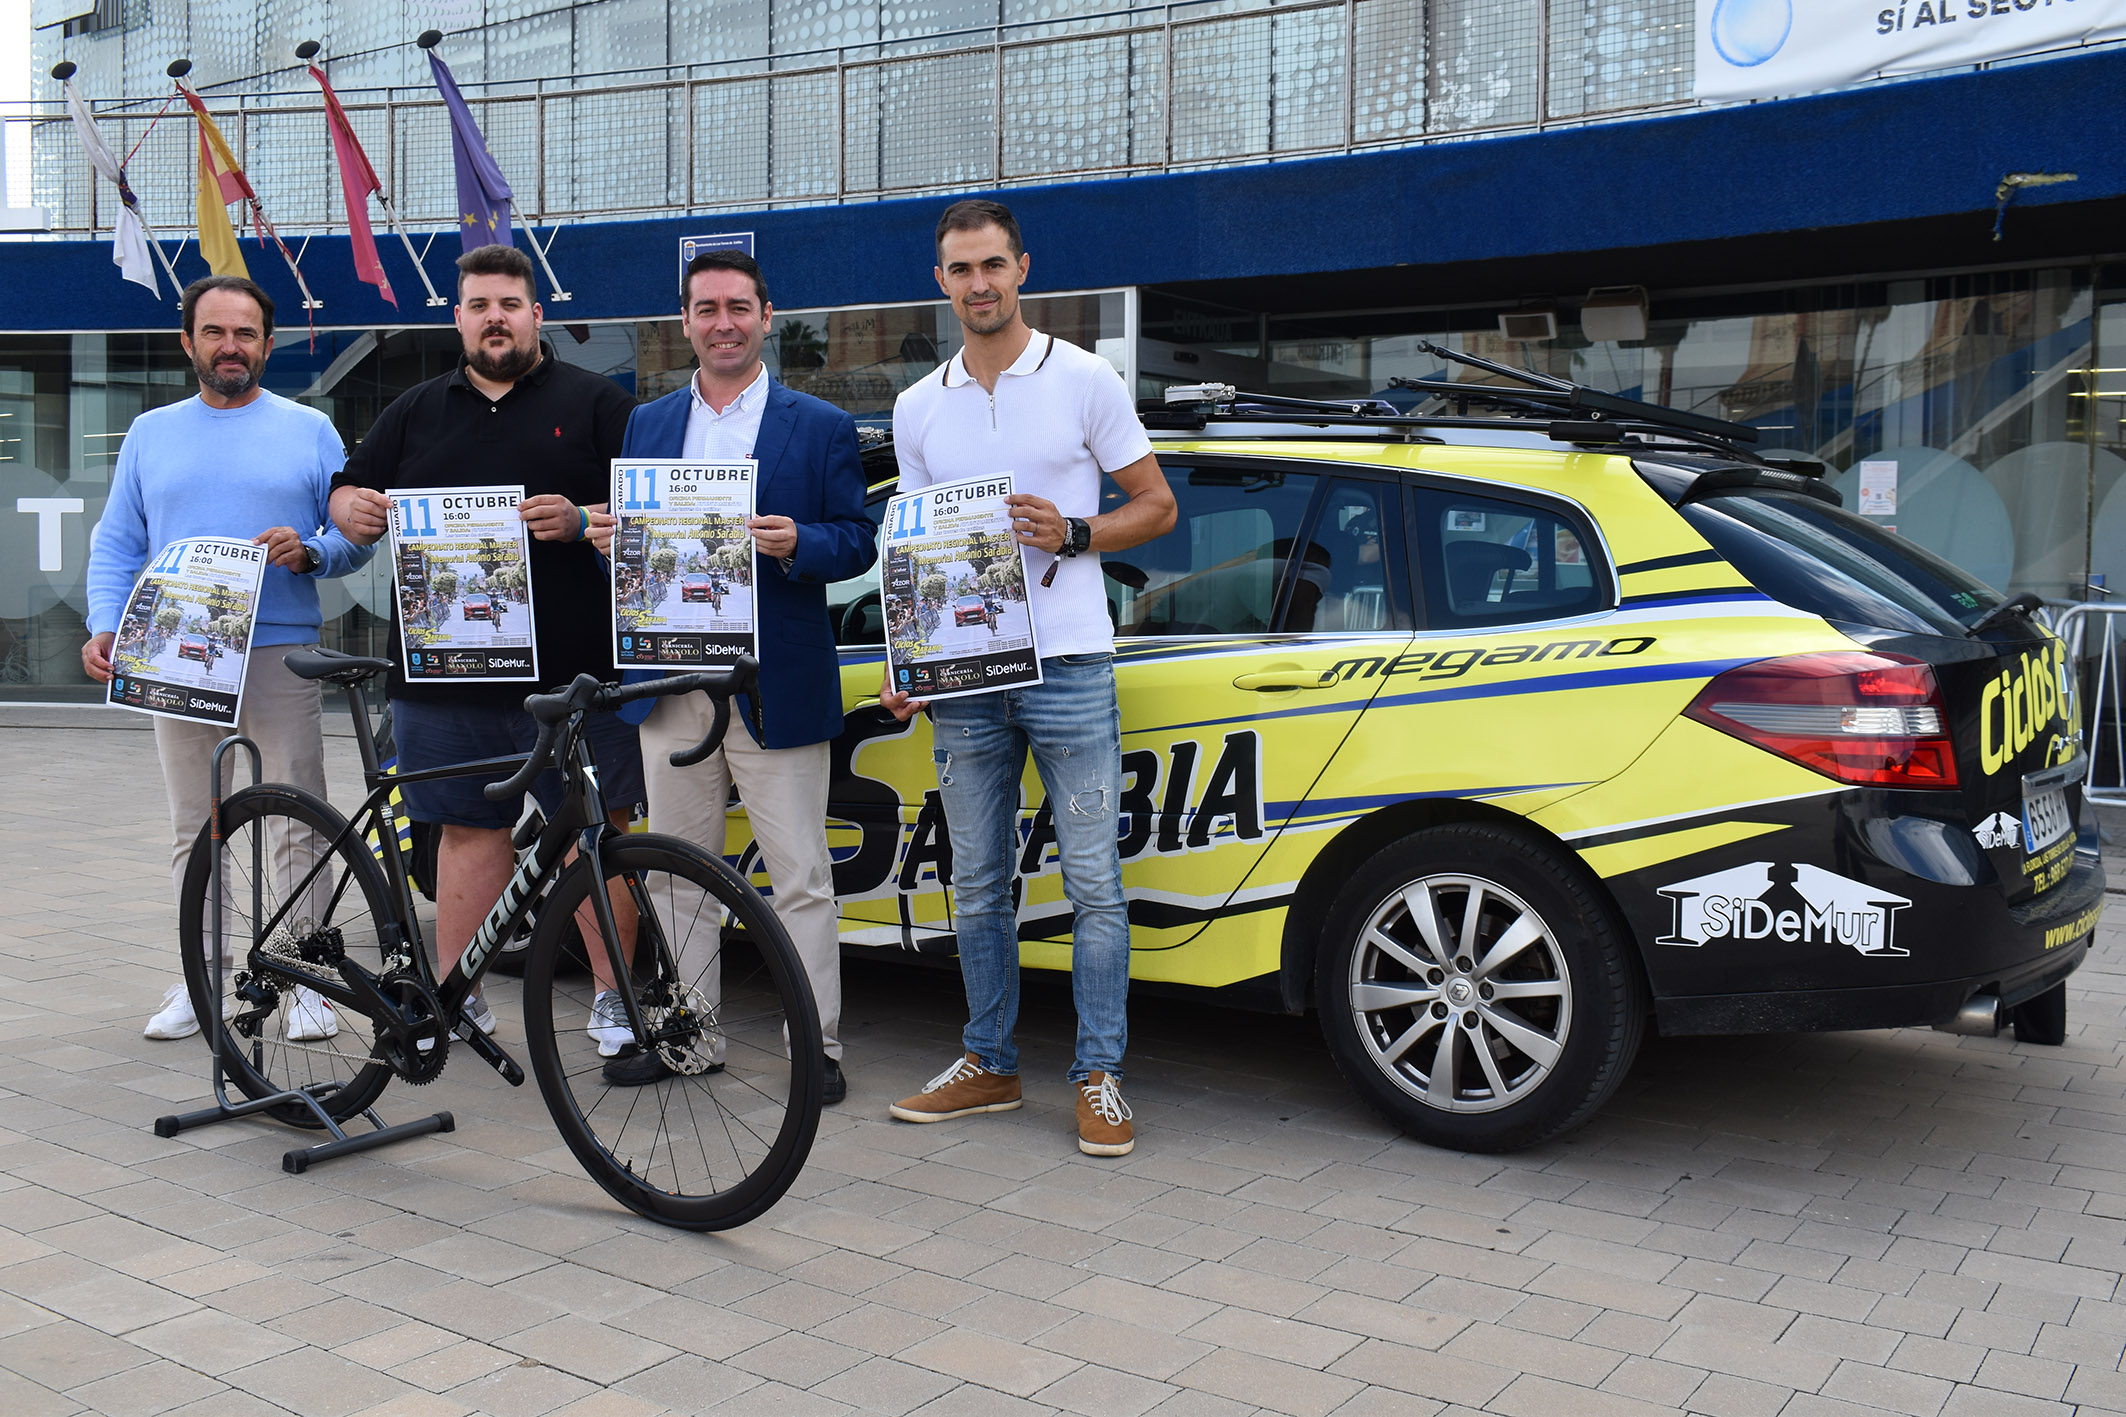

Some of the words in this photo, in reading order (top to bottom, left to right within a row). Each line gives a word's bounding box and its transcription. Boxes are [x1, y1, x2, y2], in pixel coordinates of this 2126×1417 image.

[1913, 0, 1957, 28] AL
[670, 469, 749, 481] OCTUBRE
[625, 468, 660, 509] 11
[669, 484, 697, 493] 16:00
[935, 483, 1007, 504] OCTUBRE
[442, 496, 517, 509] OCTUBRE
[933, 506, 959, 516] 16:00
[400, 498, 437, 537] 11
[442, 512, 471, 520] 16:00
[630, 517, 677, 525] CAMPEONATO
[679, 517, 711, 525] REGIONAL
[714, 517, 745, 525] MASTER
[893, 497, 926, 539] 11
[17, 498, 84, 572] T
[653, 529, 686, 539] Memorial
[688, 529, 714, 539] Antonio
[717, 528, 745, 539] Sarabia
[897, 541, 942, 554] CAMPEONATO
[944, 537, 976, 548] REGIONAL
[979, 533, 1010, 544] MASTER
[194, 544, 259, 561] OCTUBRE
[408, 542, 454, 552] CAMPEONATO
[455, 541, 487, 551] REGIONAL
[489, 540, 518, 550] MASTER
[919, 553, 952, 565] Memorial
[955, 549, 981, 561] Antonio
[984, 544, 1012, 557] Sarabia
[155, 545, 188, 574] 11
[189, 556, 213, 564] 16:00
[431, 554, 464, 564] Memorial
[466, 553, 491, 563] Antonio
[493, 551, 519, 562] Sarabia
[150, 578, 189, 589] CAMPEONATO
[190, 584, 219, 594] REGIONAL
[222, 589, 249, 600] MASTER
[165, 591, 194, 602] Memorial
[196, 596, 220, 607] Antonio
[222, 600, 247, 612] Sarabia
[705, 644, 745, 655] SiDeMur
[1321, 636, 1658, 682] megamo
[488, 657, 527, 668] SiDeMur
[986, 660, 1028, 676] SiDeMur
[1981, 646, 2056, 776] Ciclos
[460, 836, 543, 980] GIANT
[1700, 894, 1879, 946] SiDeMur
